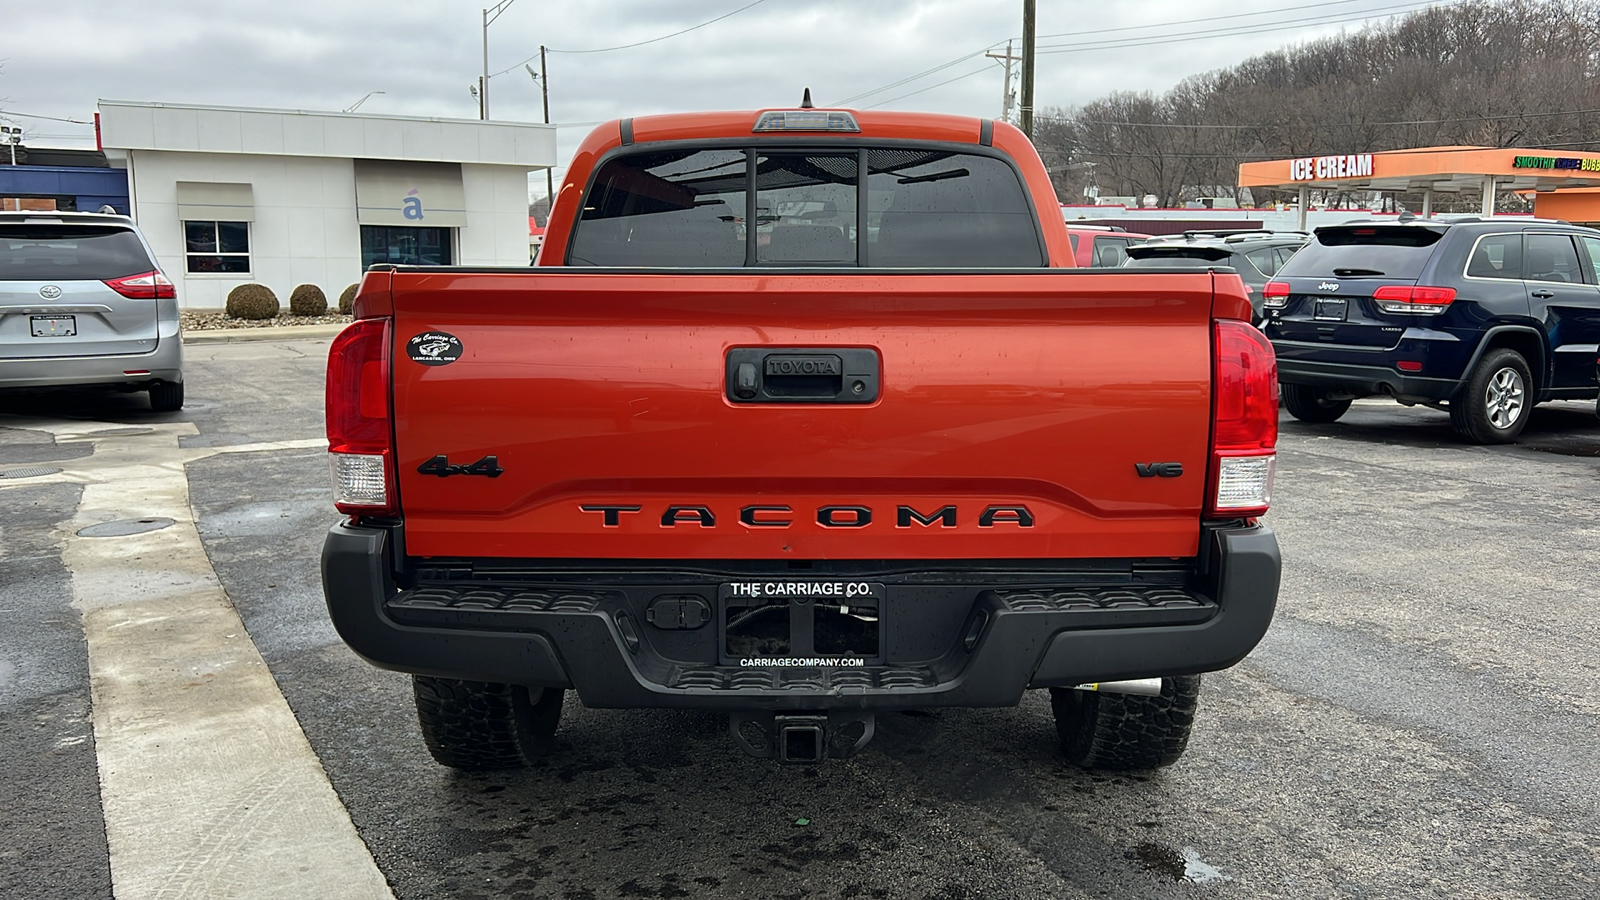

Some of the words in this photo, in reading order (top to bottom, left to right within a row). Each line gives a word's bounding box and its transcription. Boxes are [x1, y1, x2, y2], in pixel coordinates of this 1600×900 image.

[1290, 158, 1314, 180] ICE
[1316, 154, 1374, 179] CREAM
[1318, 281, 1340, 292] Jeep
[422, 333, 449, 342] Carriage
[769, 359, 836, 375] TOYOTA
[416, 454, 504, 478] 4x4
[1134, 462, 1183, 477] V6
[578, 503, 1035, 530] TACOMA
[730, 582, 761, 596] THE
[764, 582, 843, 596] CARRIAGE
[846, 582, 873, 596] CO.
[740, 657, 864, 667] CARRIAGECOMPANY.COM
